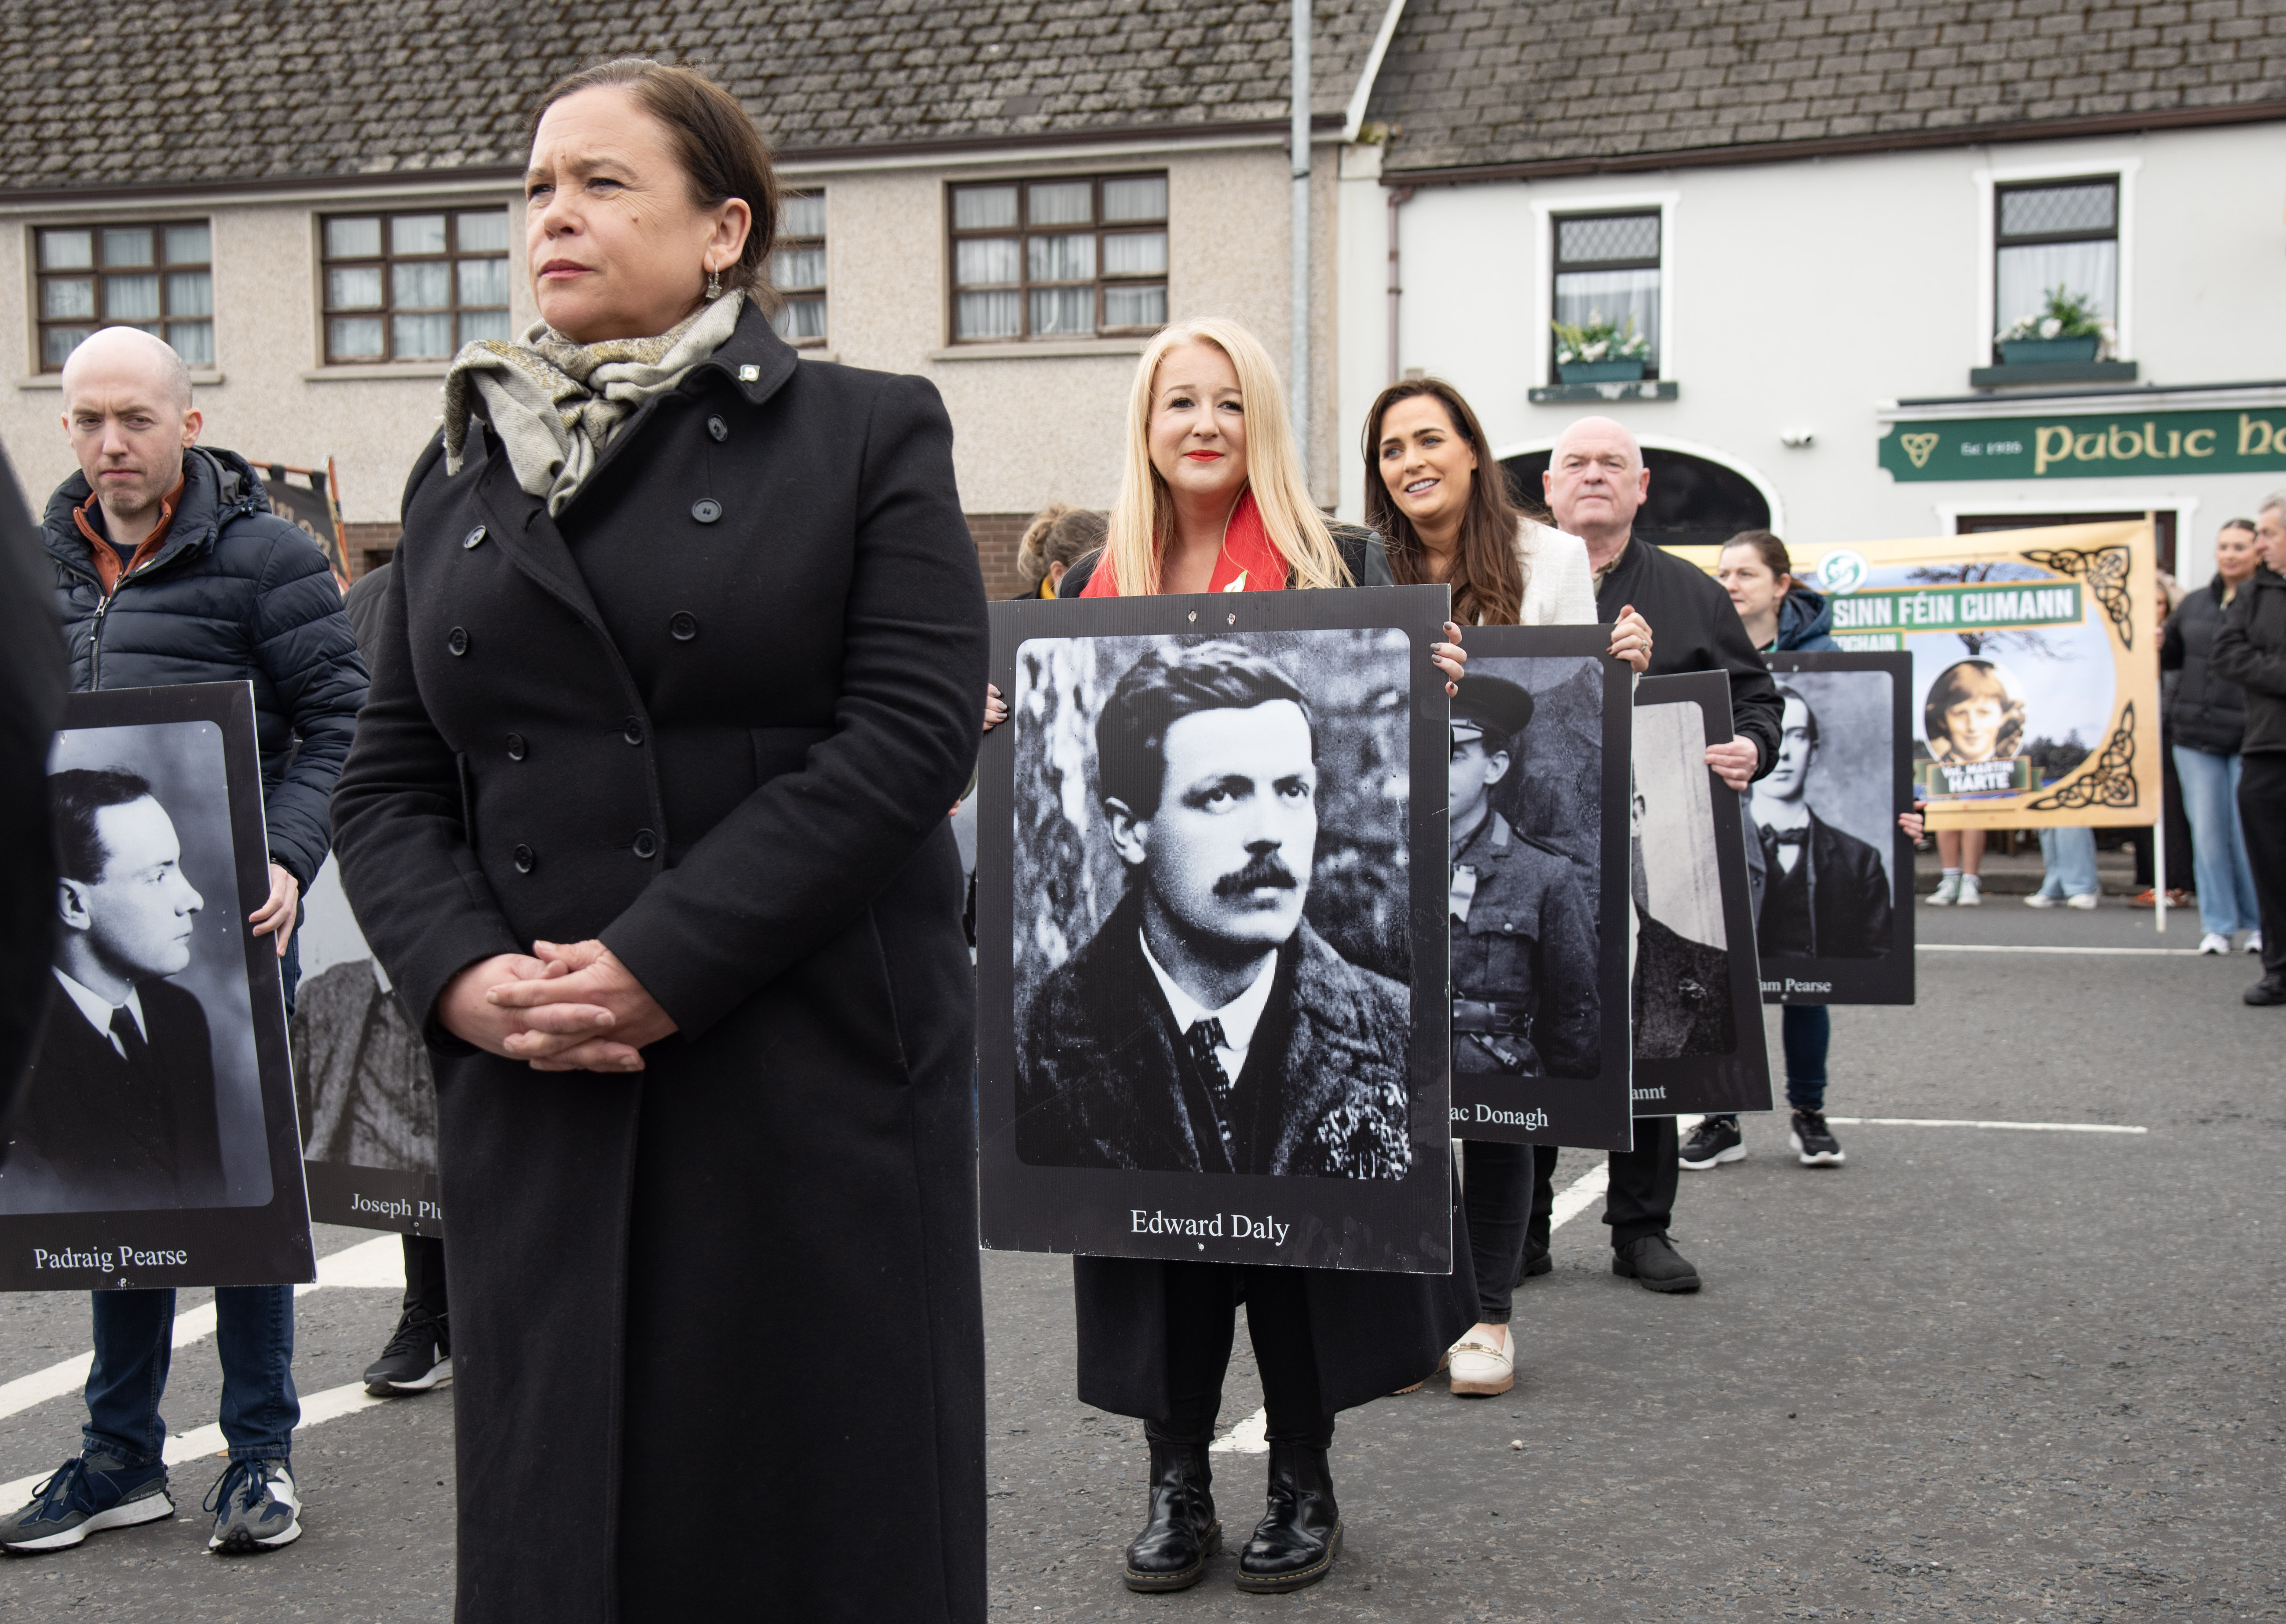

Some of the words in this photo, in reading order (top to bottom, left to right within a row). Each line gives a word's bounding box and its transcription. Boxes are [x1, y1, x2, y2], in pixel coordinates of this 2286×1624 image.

[1832, 597, 1891, 628] SINN
[1898, 591, 1955, 624] FÉIN
[1960, 588, 2074, 622] CUMANN
[1965, 760, 2015, 774] MARTIN
[1948, 771, 2011, 793] HARTE
[1784, 977, 1832, 993] Pearse
[1475, 1103, 1549, 1131] Donagh
[351, 1193, 412, 1219] Joseph
[1130, 1209, 1224, 1237] Edward
[1230, 1214, 1290, 1246] Daly
[33, 1246, 114, 1273] Padraig
[118, 1245, 187, 1266] Pearse
[140, 1488, 161, 1499] balance
